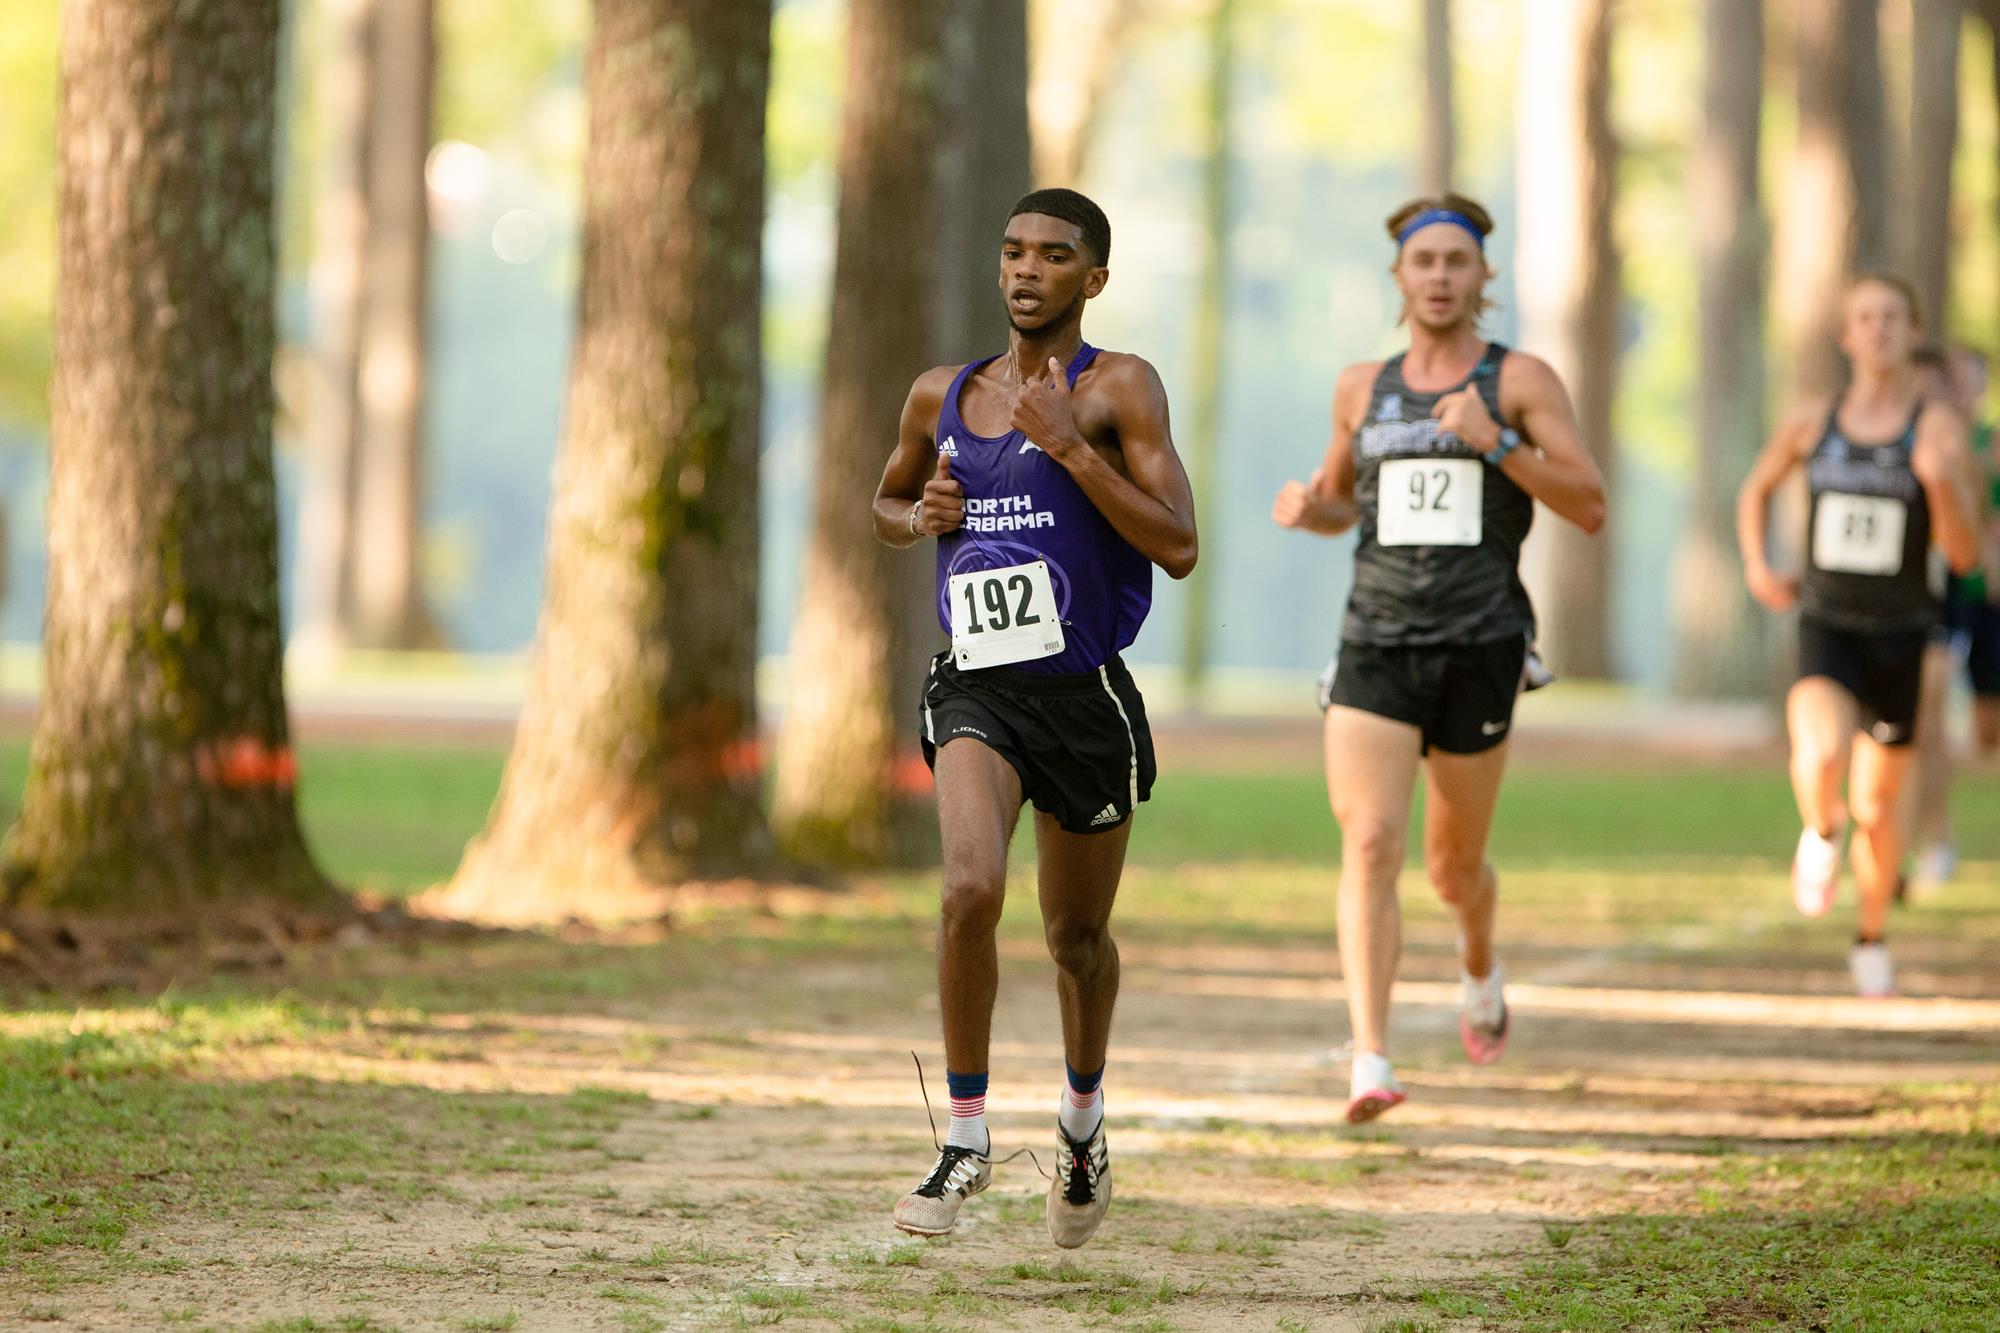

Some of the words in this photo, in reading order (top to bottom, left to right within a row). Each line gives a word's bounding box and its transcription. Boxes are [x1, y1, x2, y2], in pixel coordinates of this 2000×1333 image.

[1409, 469, 1451, 511] 92
[961, 494, 1032, 514] ORTH
[959, 511, 1055, 532] ABAMA
[964, 574, 1041, 635] 192
[952, 726, 988, 739] LIONS
